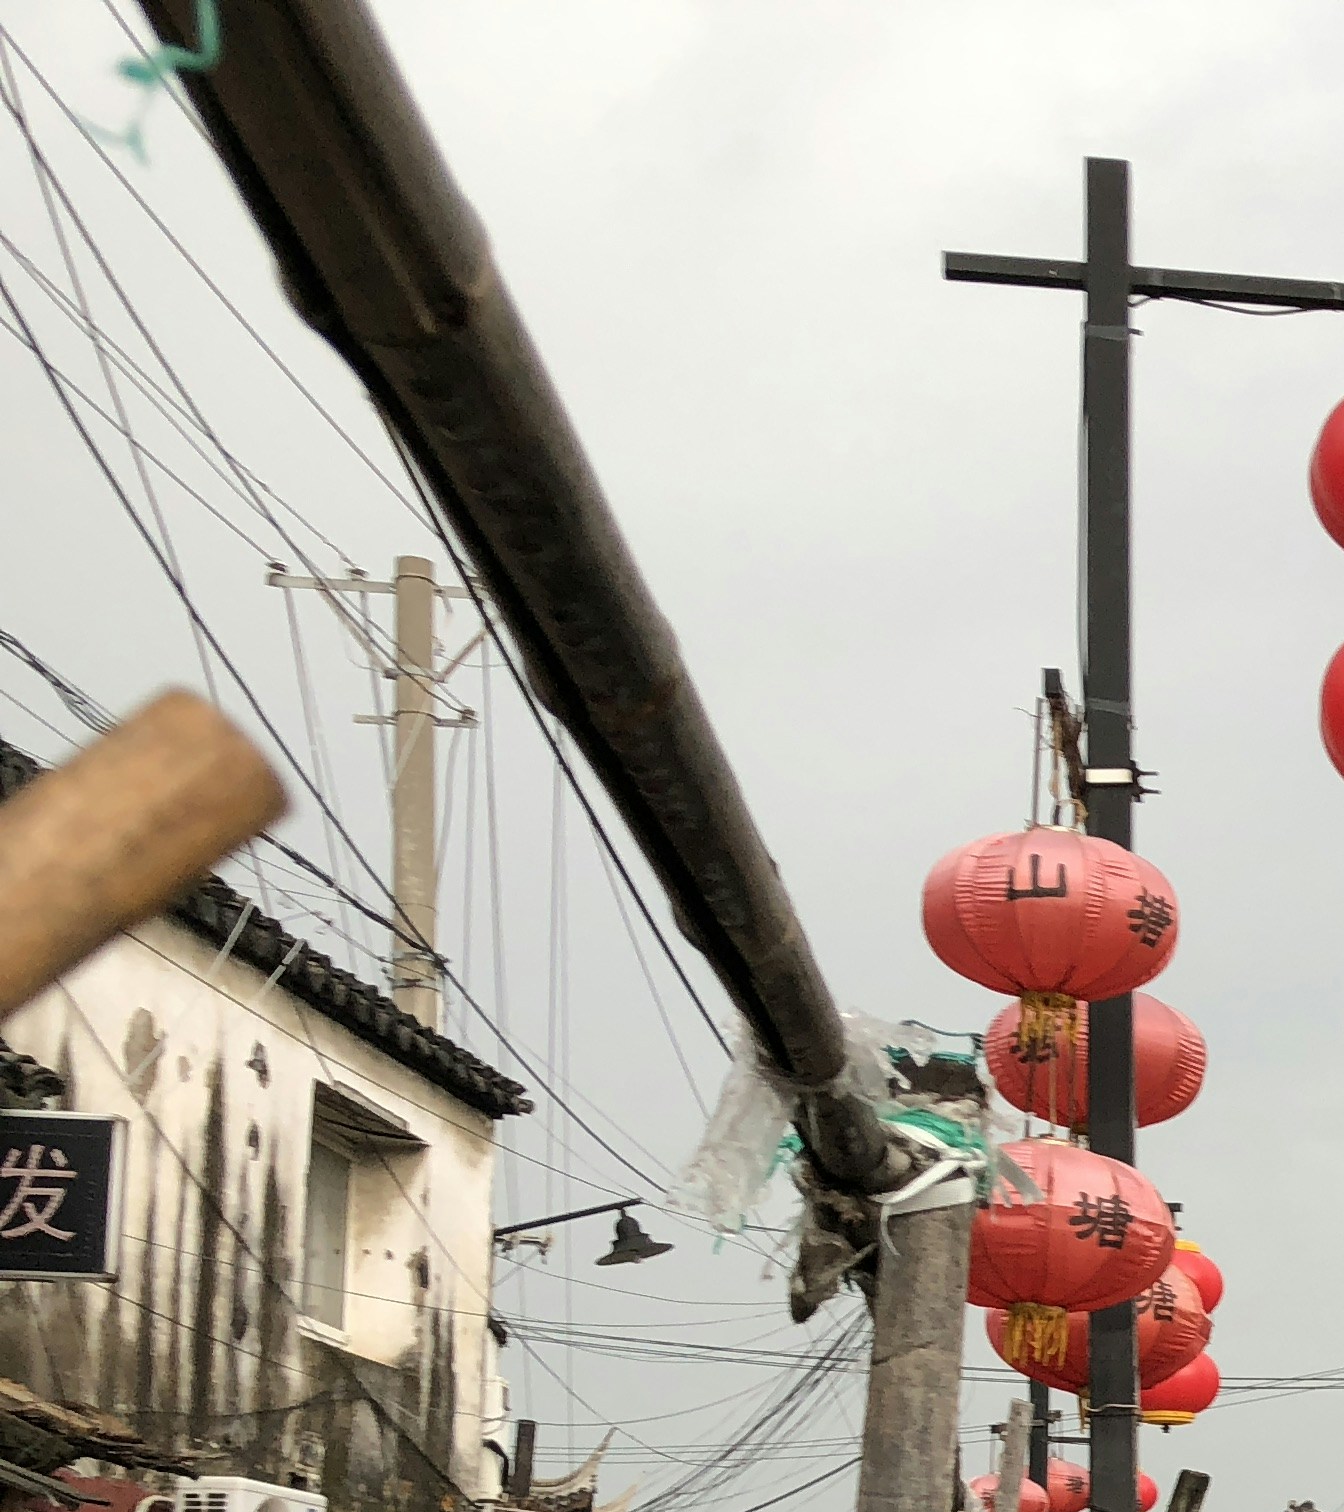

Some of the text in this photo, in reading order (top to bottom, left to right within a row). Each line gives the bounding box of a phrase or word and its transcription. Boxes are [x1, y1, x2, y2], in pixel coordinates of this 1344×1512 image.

[1005, 852, 1175, 949] 山 塘
[0, 1143, 79, 1243] 发
[1068, 1190, 1135, 1249] 塘
